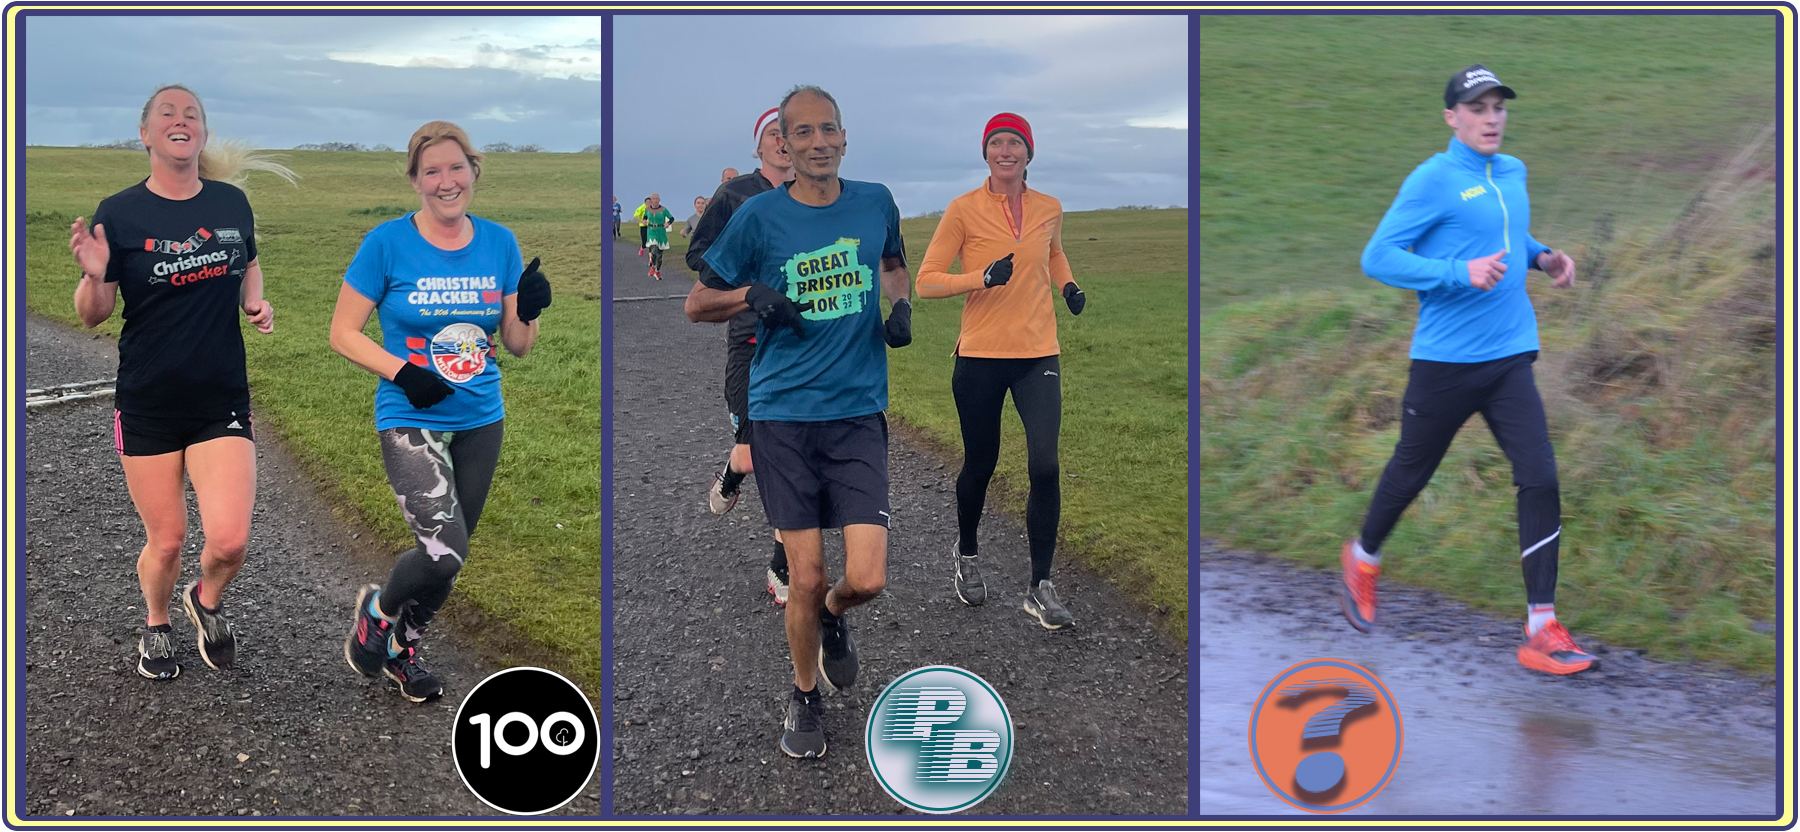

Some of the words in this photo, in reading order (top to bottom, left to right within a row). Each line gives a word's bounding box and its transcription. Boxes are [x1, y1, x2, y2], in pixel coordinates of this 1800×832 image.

[153, 250, 228, 276] Christmas
[797, 251, 849, 277] GREAT
[171, 264, 228, 286] Cracker
[417, 276, 496, 290] CHRISTMAS
[797, 270, 862, 296] BRISTOL
[408, 291, 479, 304] CRACKER
[842, 293, 852, 301] 20
[843, 301, 852, 309] 22
[437, 357, 459, 379] WESTON
